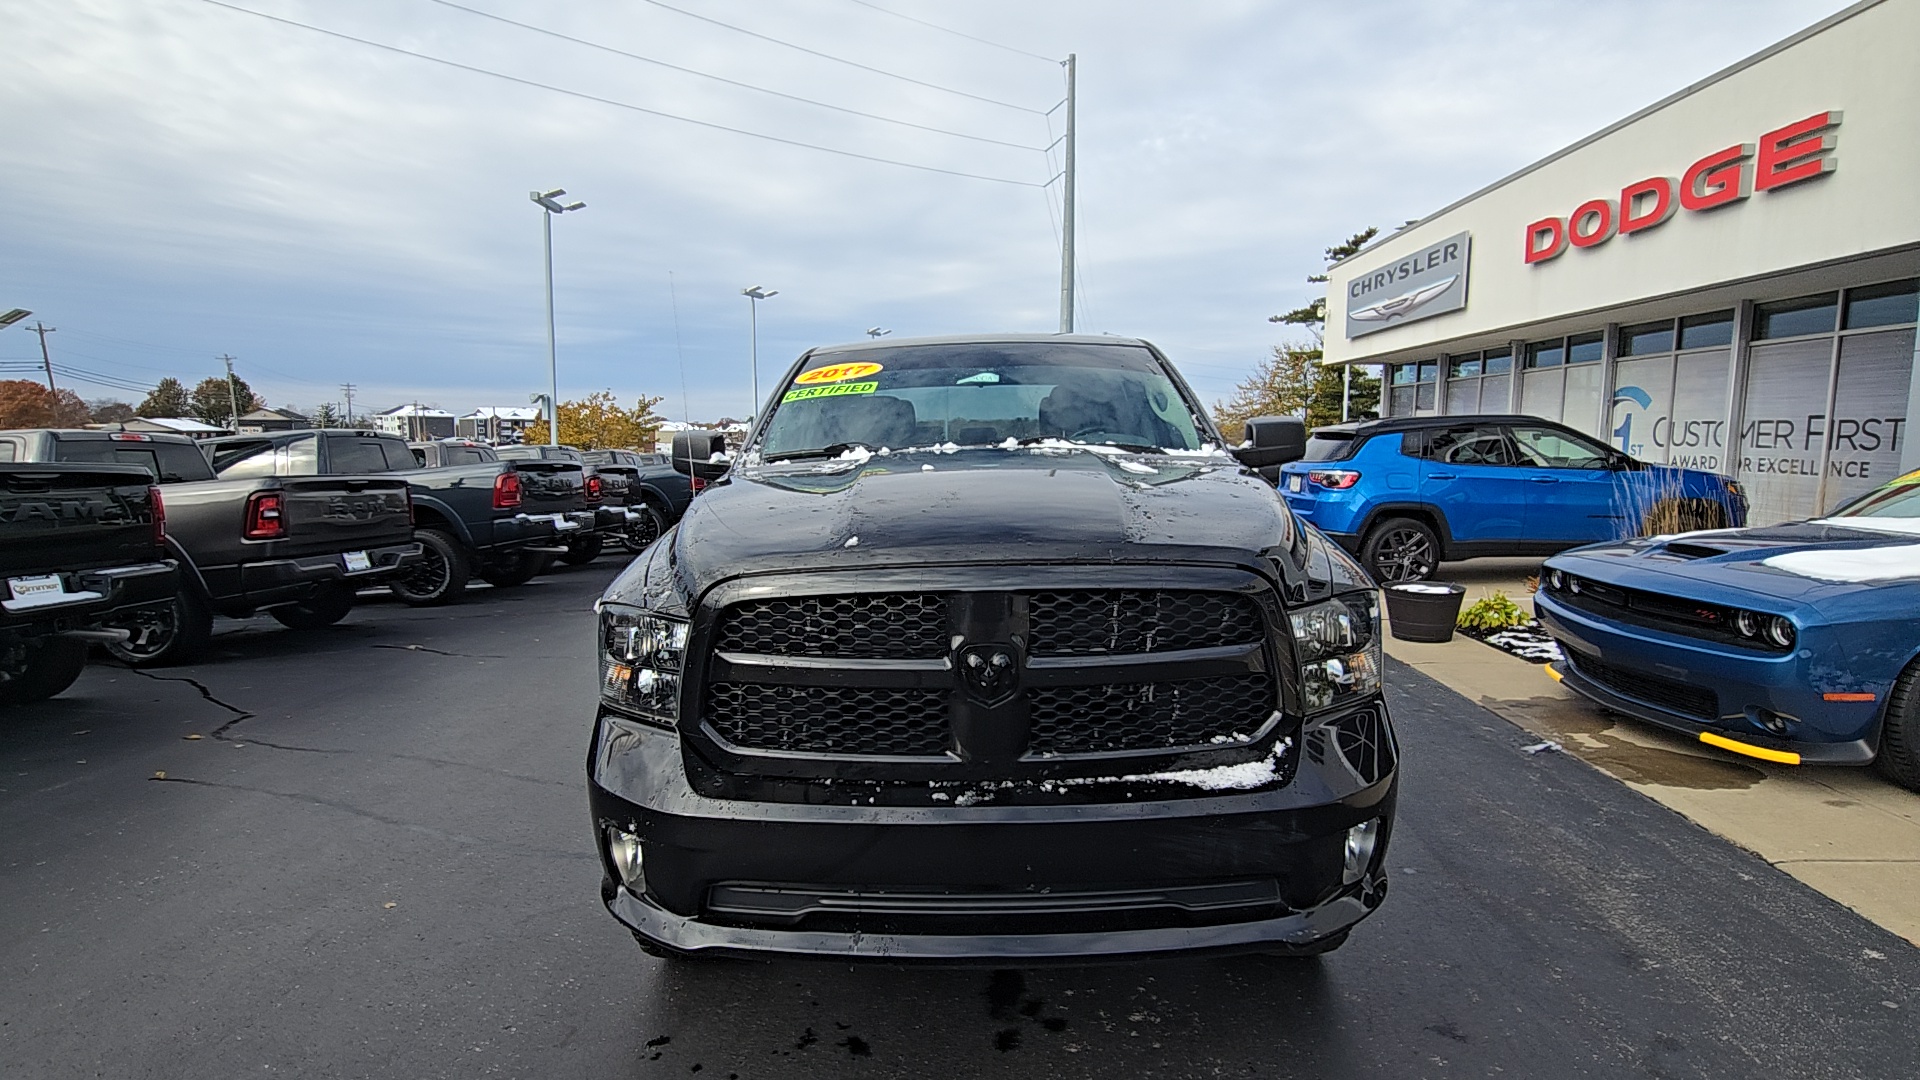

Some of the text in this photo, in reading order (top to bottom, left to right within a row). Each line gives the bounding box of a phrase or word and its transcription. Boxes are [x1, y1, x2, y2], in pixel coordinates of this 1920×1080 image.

[1525, 110, 1843, 264] DODGE
[1350, 242, 1458, 298] CHRYSLER
[803, 365, 873, 382] 2017
[785, 383, 874, 401] CERTIFIED
[1804, 414, 1907, 452] FIRST
[1670, 455, 1718, 470] AWARD
[1757, 457, 1871, 479] EXCELLNCE
